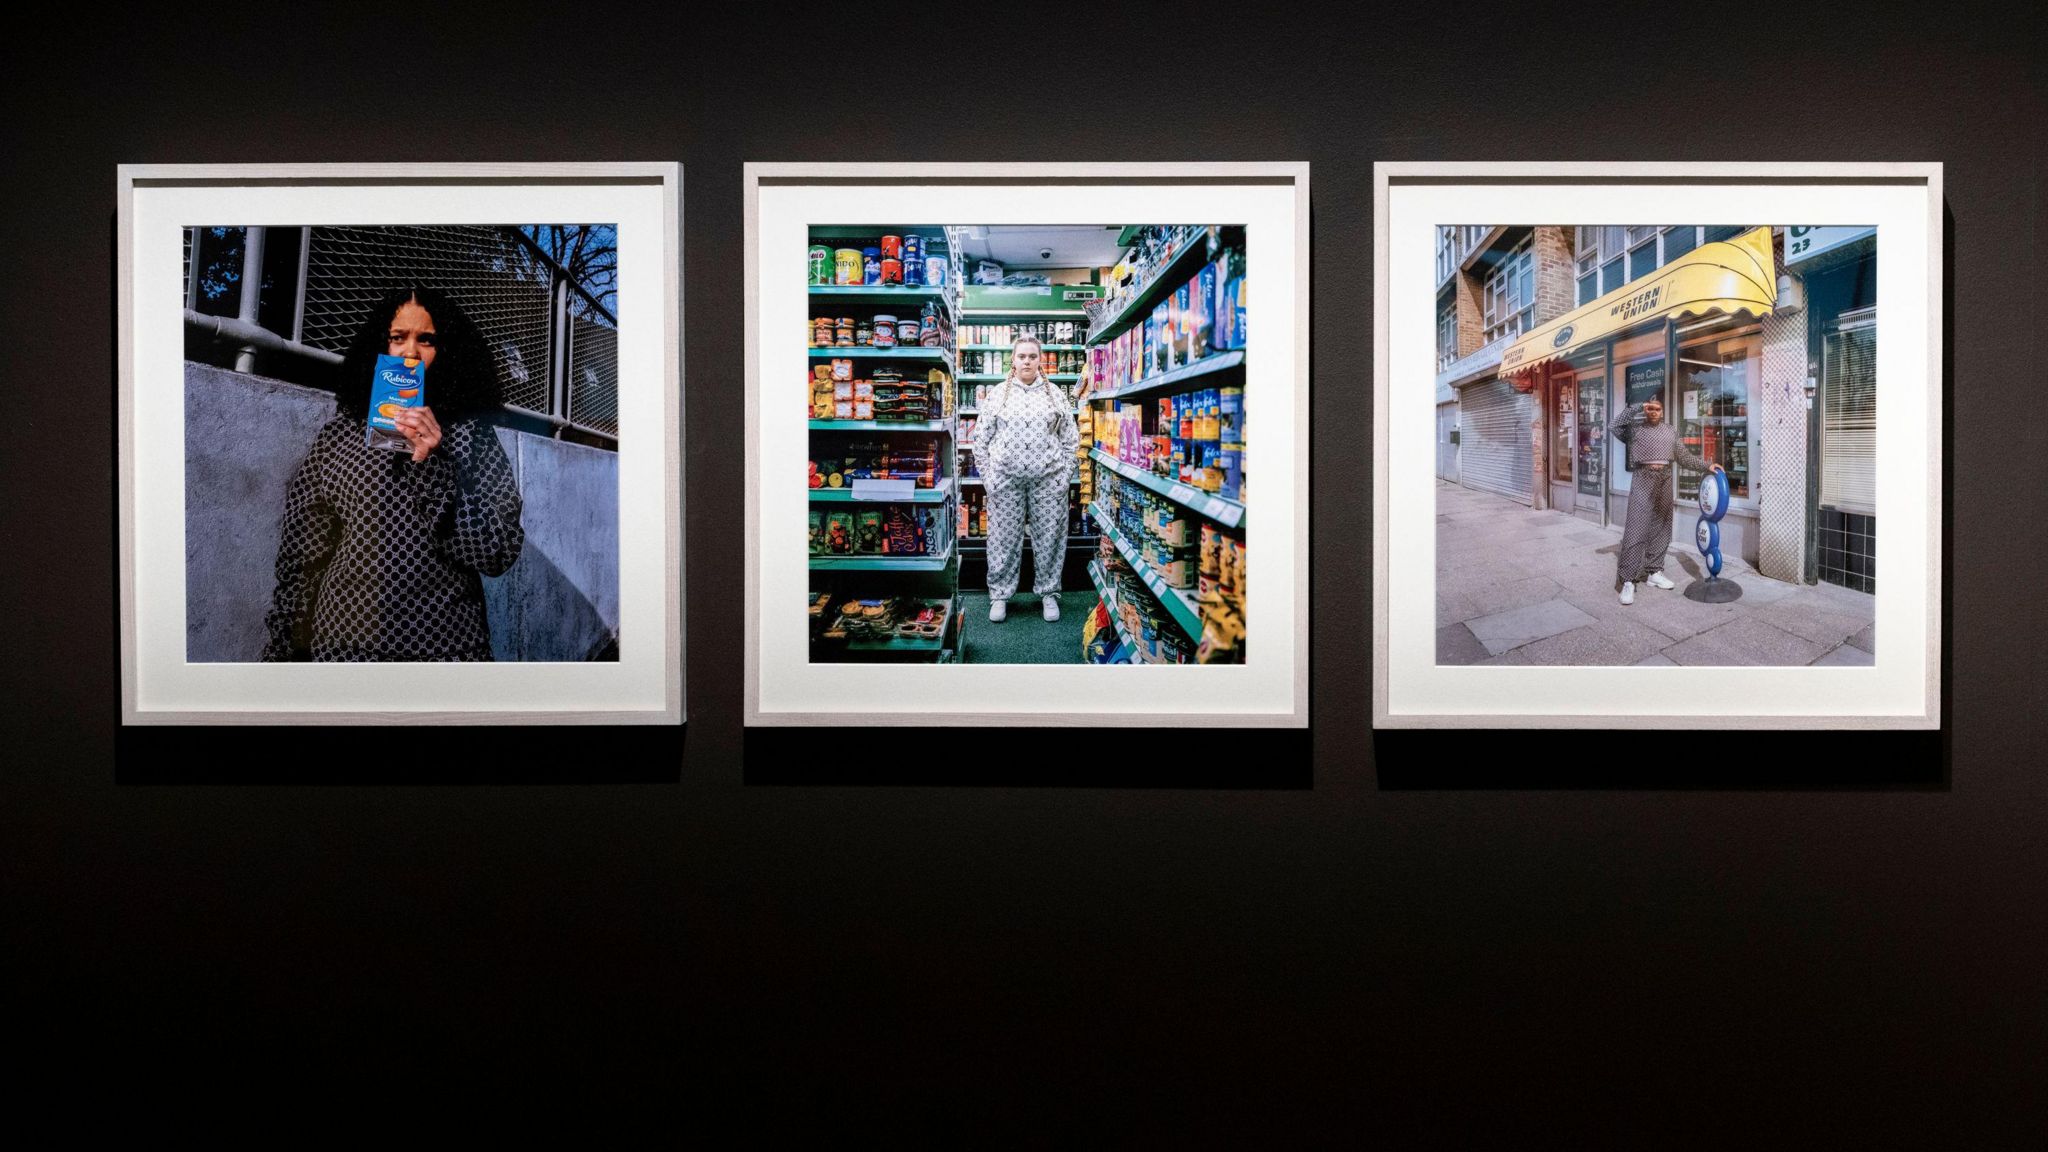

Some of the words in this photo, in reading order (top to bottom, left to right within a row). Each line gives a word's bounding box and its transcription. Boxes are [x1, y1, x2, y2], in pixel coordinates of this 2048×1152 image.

[1791, 238, 1811, 255] 23
[1610, 286, 1660, 316] WESTERN
[1623, 297, 1658, 320] UNION
[382, 371, 418, 385] Rubicon
[1630, 372, 1644, 381] Free
[1646, 368, 1664, 379] Cash
